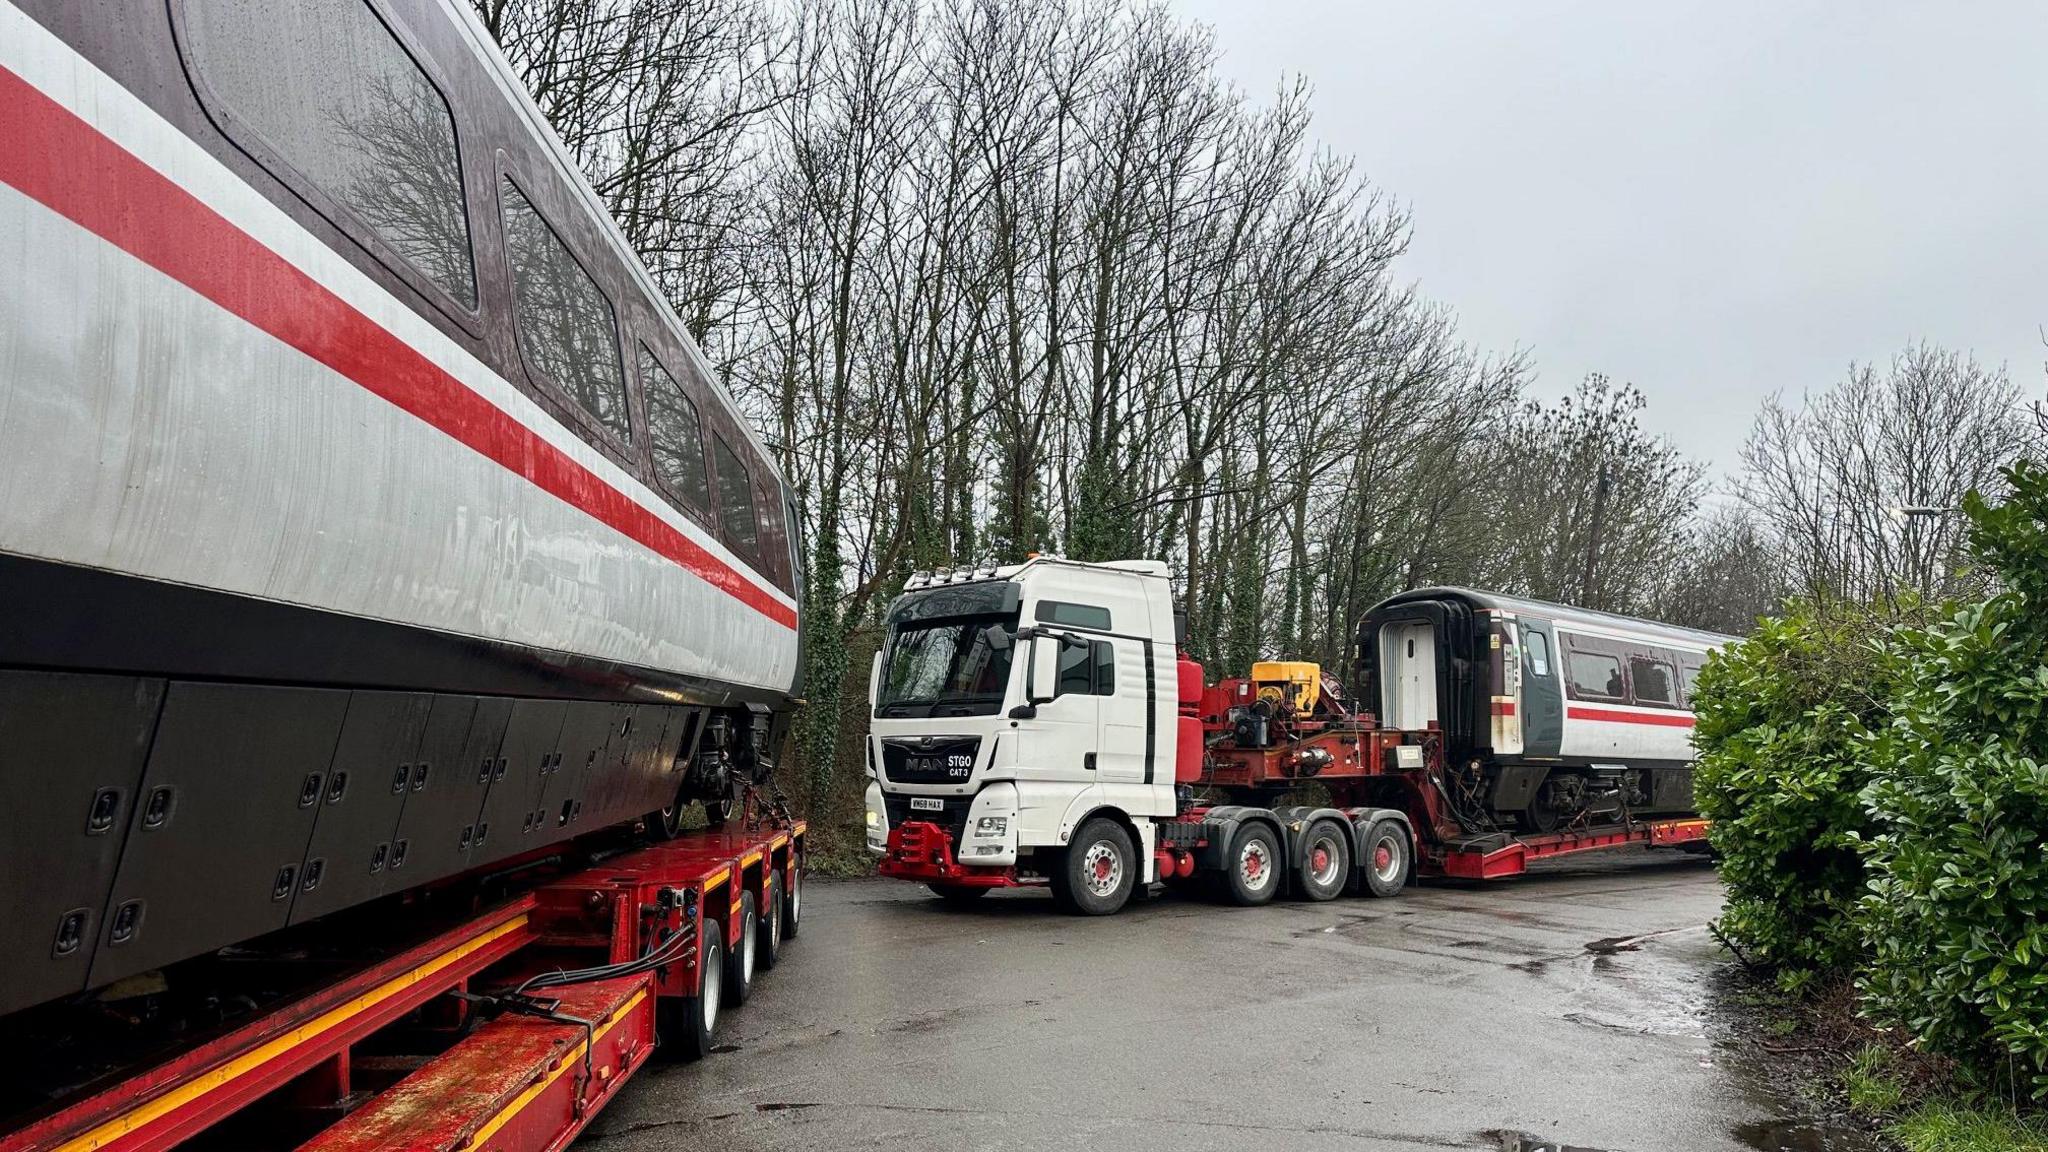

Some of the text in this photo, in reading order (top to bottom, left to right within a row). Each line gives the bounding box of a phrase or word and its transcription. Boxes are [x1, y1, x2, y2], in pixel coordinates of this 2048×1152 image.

[905, 758, 946, 771] MAN
[948, 755, 972, 767] STGO
[949, 768, 969, 777] CAT 3
[928, 800, 942, 810] HAX
